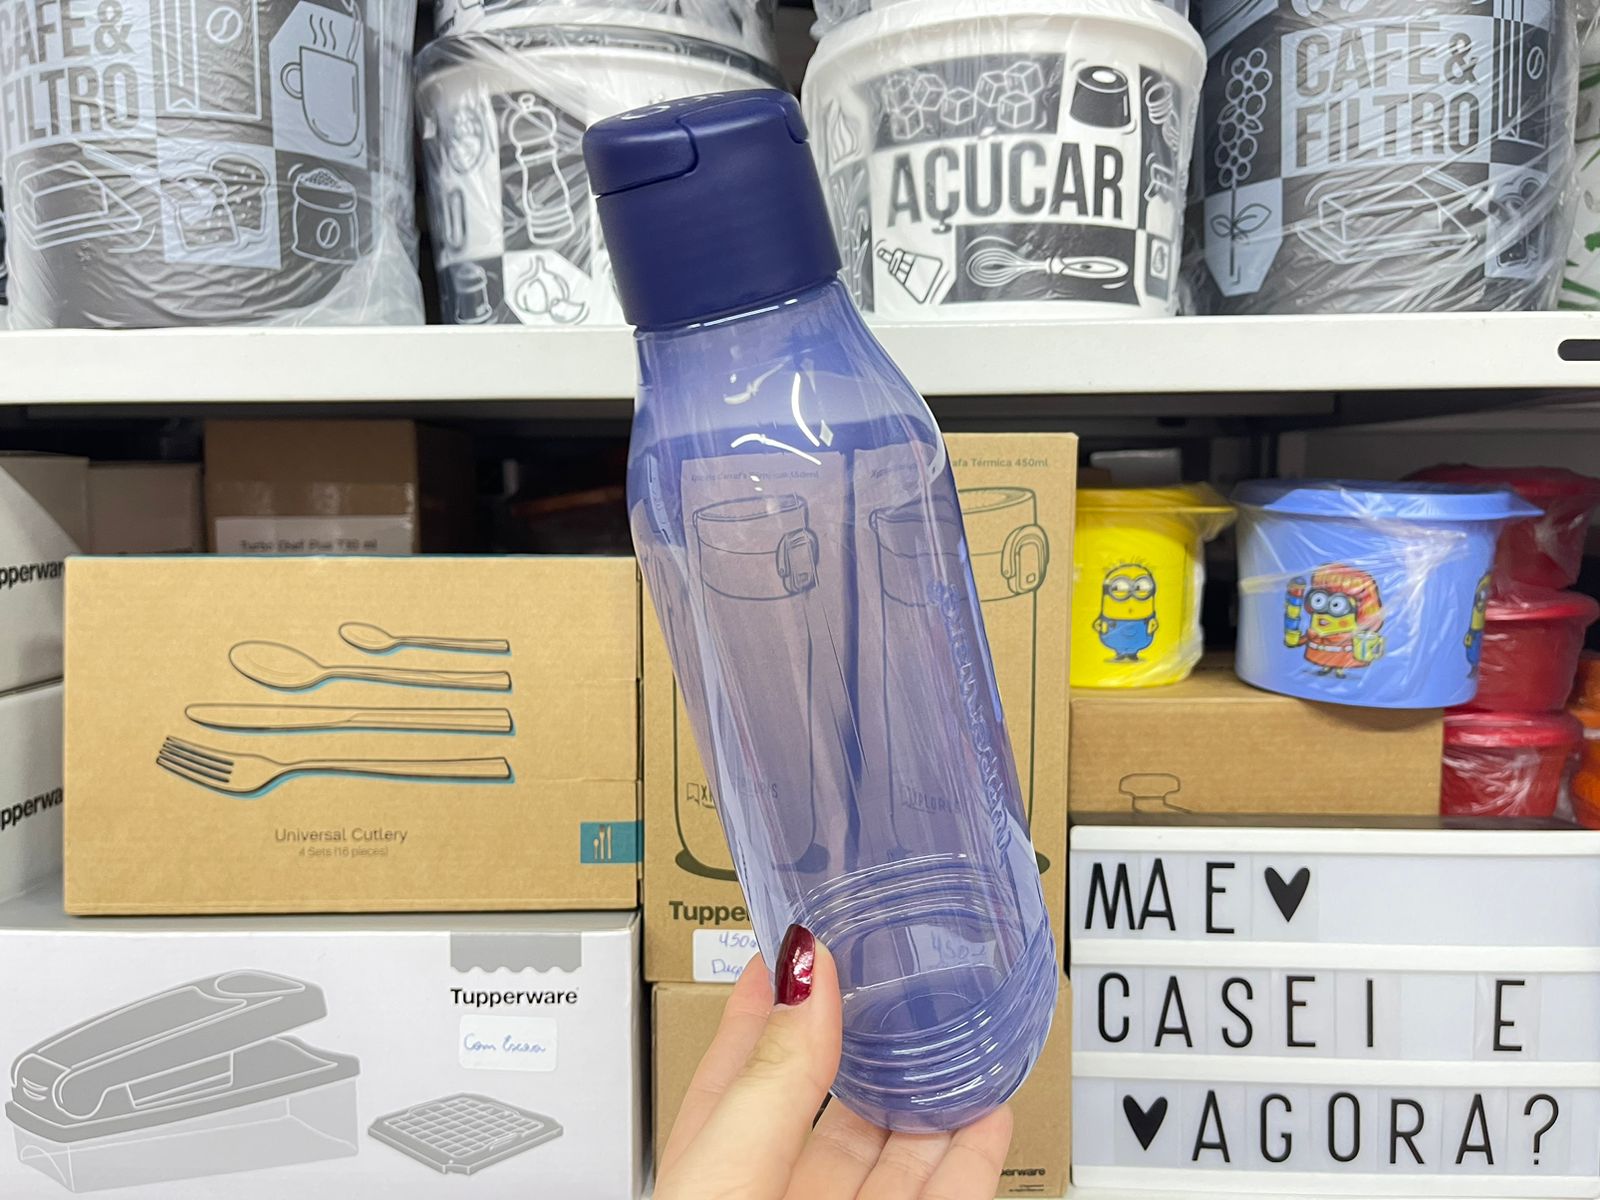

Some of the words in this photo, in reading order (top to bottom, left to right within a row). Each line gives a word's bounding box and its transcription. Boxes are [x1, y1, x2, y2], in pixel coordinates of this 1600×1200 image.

[2, 63, 139, 150] FILTRO
[1296, 92, 1480, 167] FILTRO
[887, 126, 1124, 234] AÇÚCAR
[972, 457, 1012, 467] Térmica
[1015, 457, 1048, 467] 450ml
[275, 827, 346, 841] Universal
[351, 827, 408, 845] Cutlery
[450, 987, 578, 1007] Tupperware
[1098, 972, 1373, 1048] CASEI
[1493, 980, 1526, 1052] E
[1192, 1090, 1560, 1165] AGORA?
